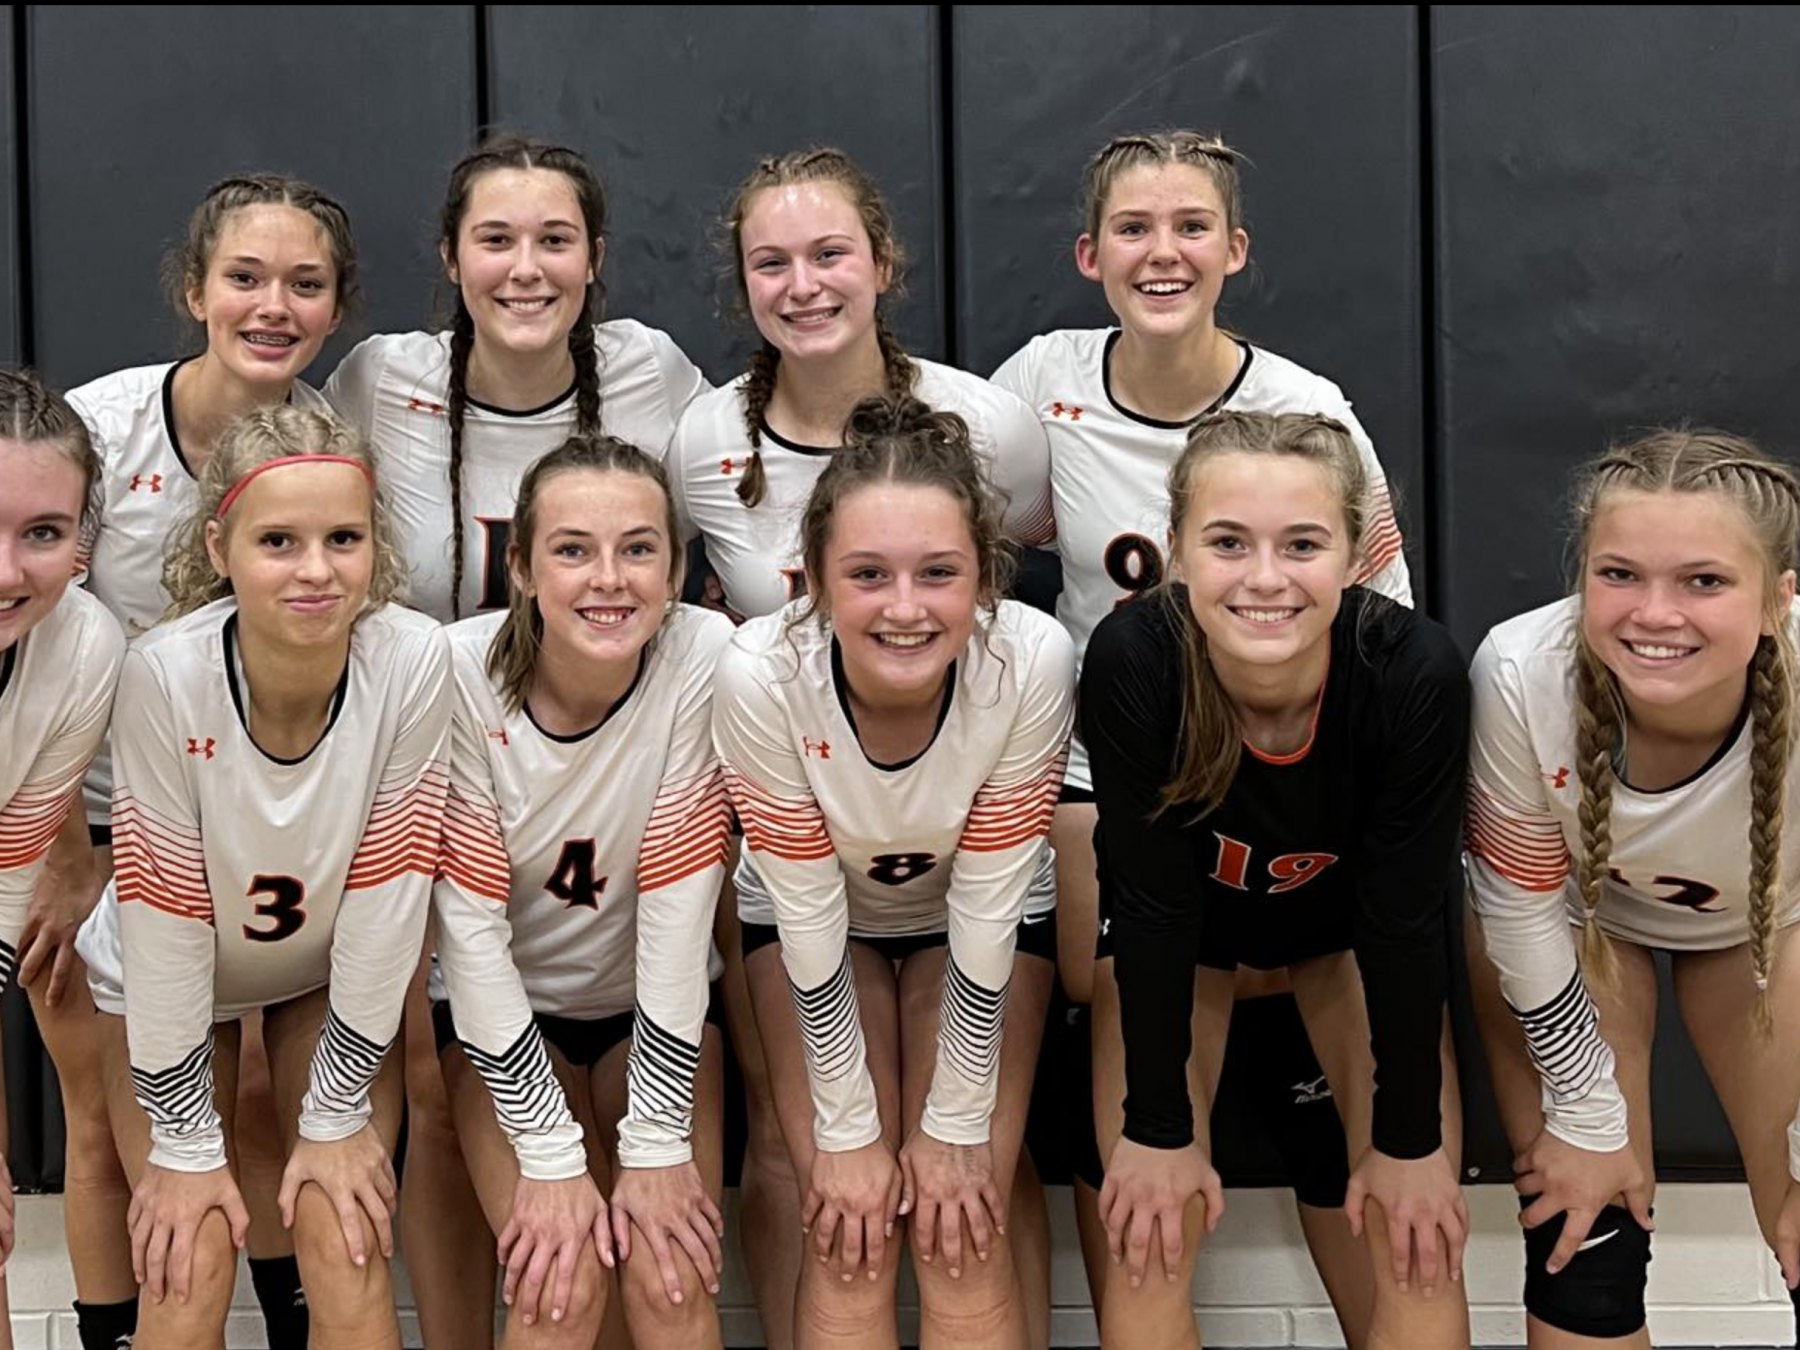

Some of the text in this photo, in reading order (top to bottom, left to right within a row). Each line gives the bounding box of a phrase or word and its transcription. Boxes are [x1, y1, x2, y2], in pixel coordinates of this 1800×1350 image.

[543, 837, 608, 910] 4
[867, 852, 937, 886] 8
[1208, 830, 1339, 893] 19
[242, 874, 307, 943] 3
